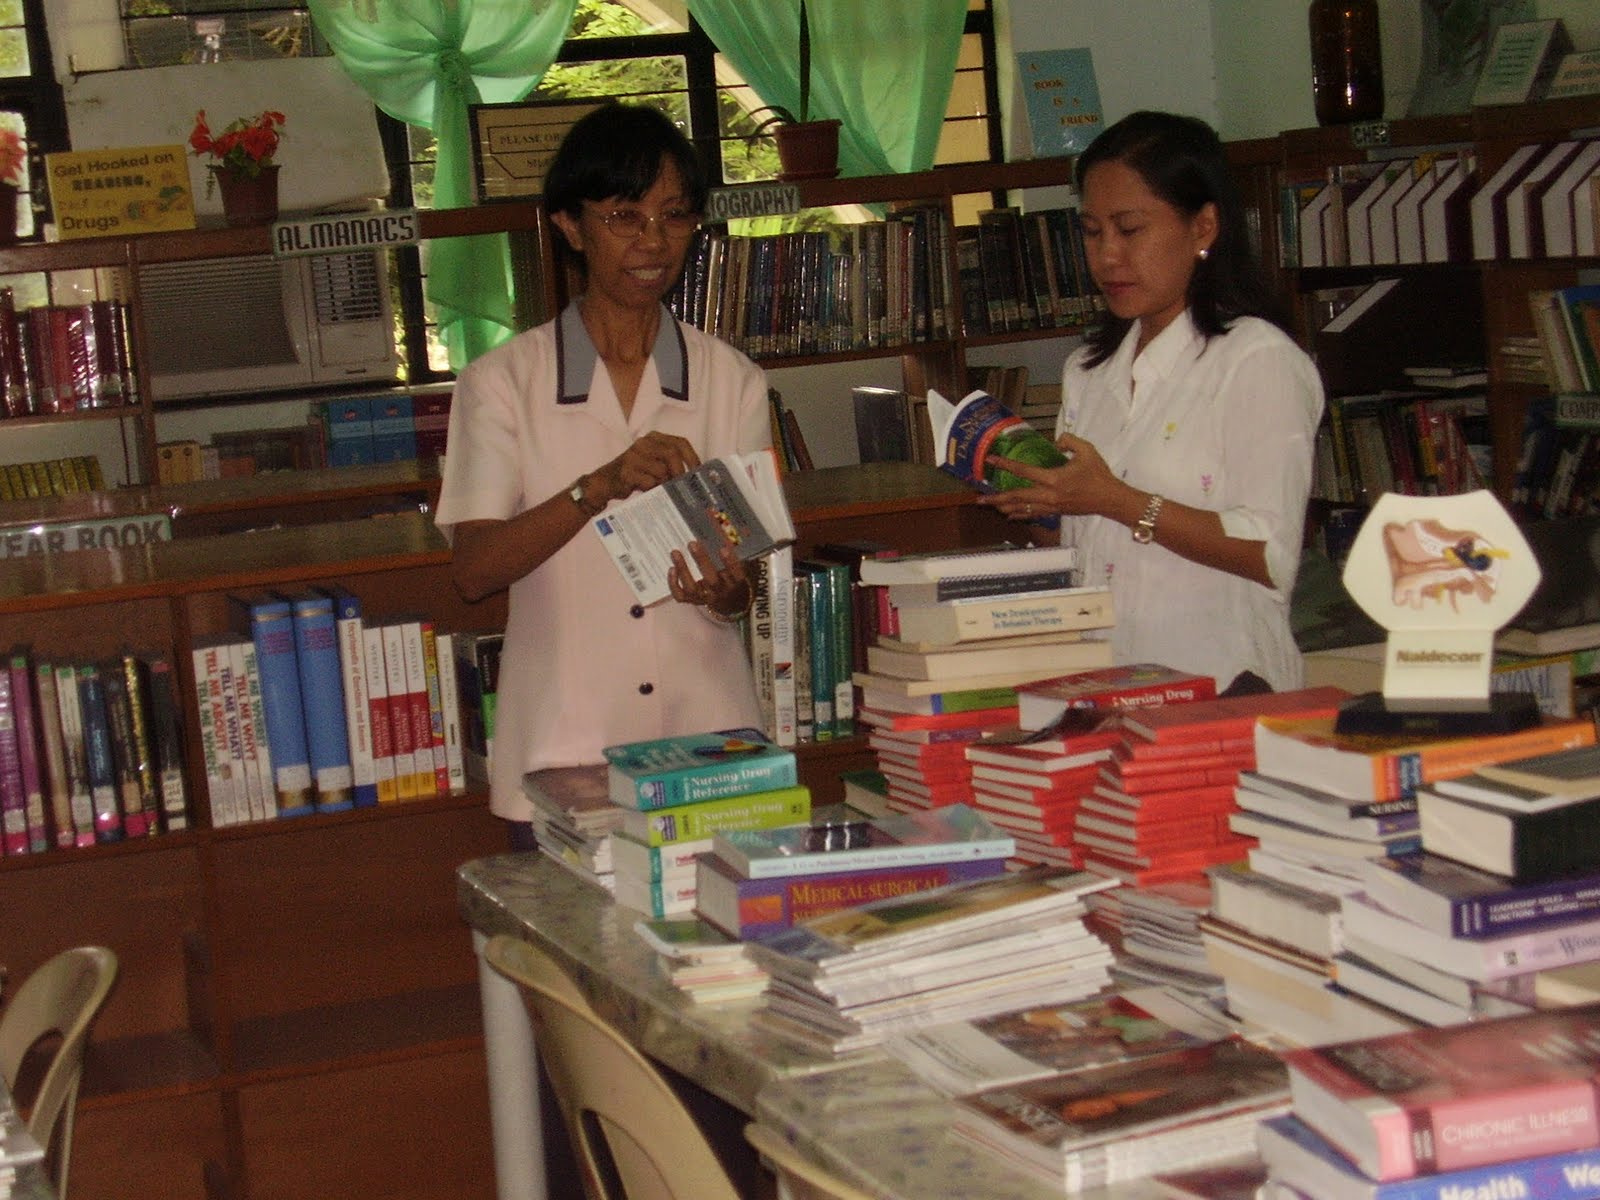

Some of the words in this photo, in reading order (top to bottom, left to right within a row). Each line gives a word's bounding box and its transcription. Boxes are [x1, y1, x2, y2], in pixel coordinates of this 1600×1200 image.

[54, 164, 82, 178] Get
[88, 154, 149, 172] Hooked
[154, 153, 174, 164] on
[62, 216, 119, 231] Drugs
[278, 215, 414, 251] ALMANACS
[5, 530, 65, 556] EAR
[77, 520, 163, 550] BOOK
[756, 560, 770, 619] GROWING
[757, 622, 770, 640] UP
[206, 651, 218, 675] TELL
[209, 679, 221, 697] ME
[221, 667, 234, 692] TELL
[235, 674, 248, 700] TELL
[224, 695, 235, 713] ME
[1119, 693, 1164, 707] Nursing
[1166, 689, 1194, 701] Drug
[240, 703, 251, 719] ME
[227, 716, 241, 760] WHAT?
[690, 769, 738, 786] Nursing
[741, 766, 772, 781] Drug
[692, 783, 752, 800] Reference
[703, 806, 749, 821] Nursing
[753, 802, 784, 815] Drug
[704, 819, 761, 833] Reference
[1442, 1115, 1523, 1145] CHRONIC
[1529, 1105, 1589, 1129] ILLNESS
[1439, 1172, 1528, 1200] Health
